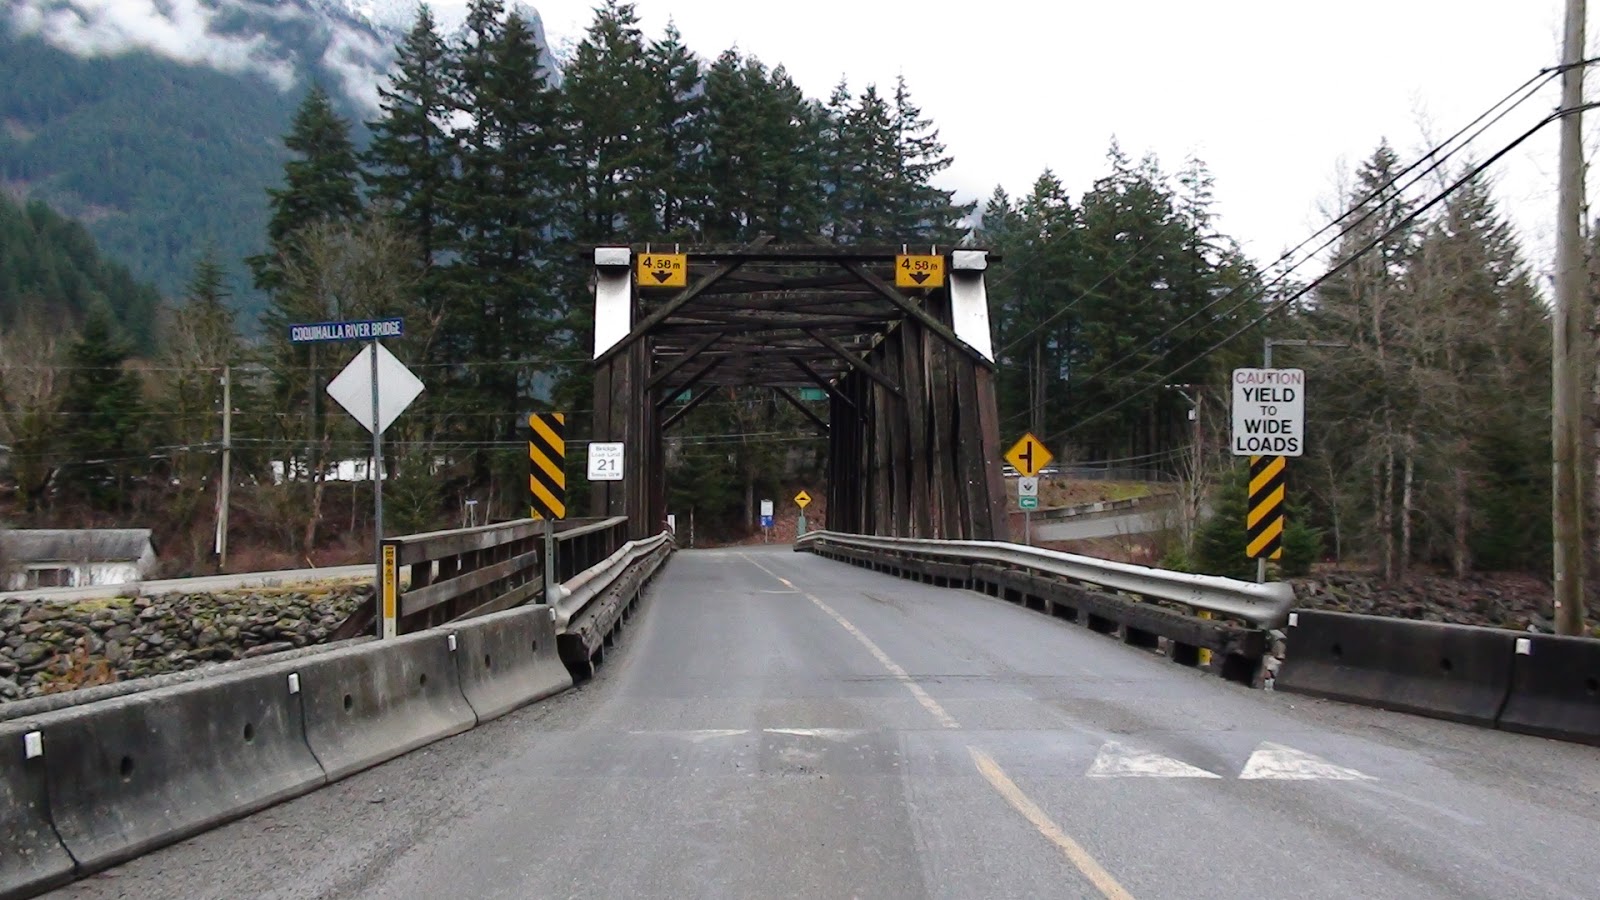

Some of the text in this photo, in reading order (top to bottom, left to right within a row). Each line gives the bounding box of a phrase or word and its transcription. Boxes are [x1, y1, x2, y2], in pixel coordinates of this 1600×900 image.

[292, 321, 401, 341] COQUIHALLA RIVER BRIDGE
[1236, 372, 1301, 385] CAUTION
[1242, 387, 1296, 402] YIELD
[1259, 405, 1278, 416] TO
[1244, 419, 1293, 434] WIDE
[1237, 437, 1299, 452] LOADS
[597, 458, 615, 471] 21
